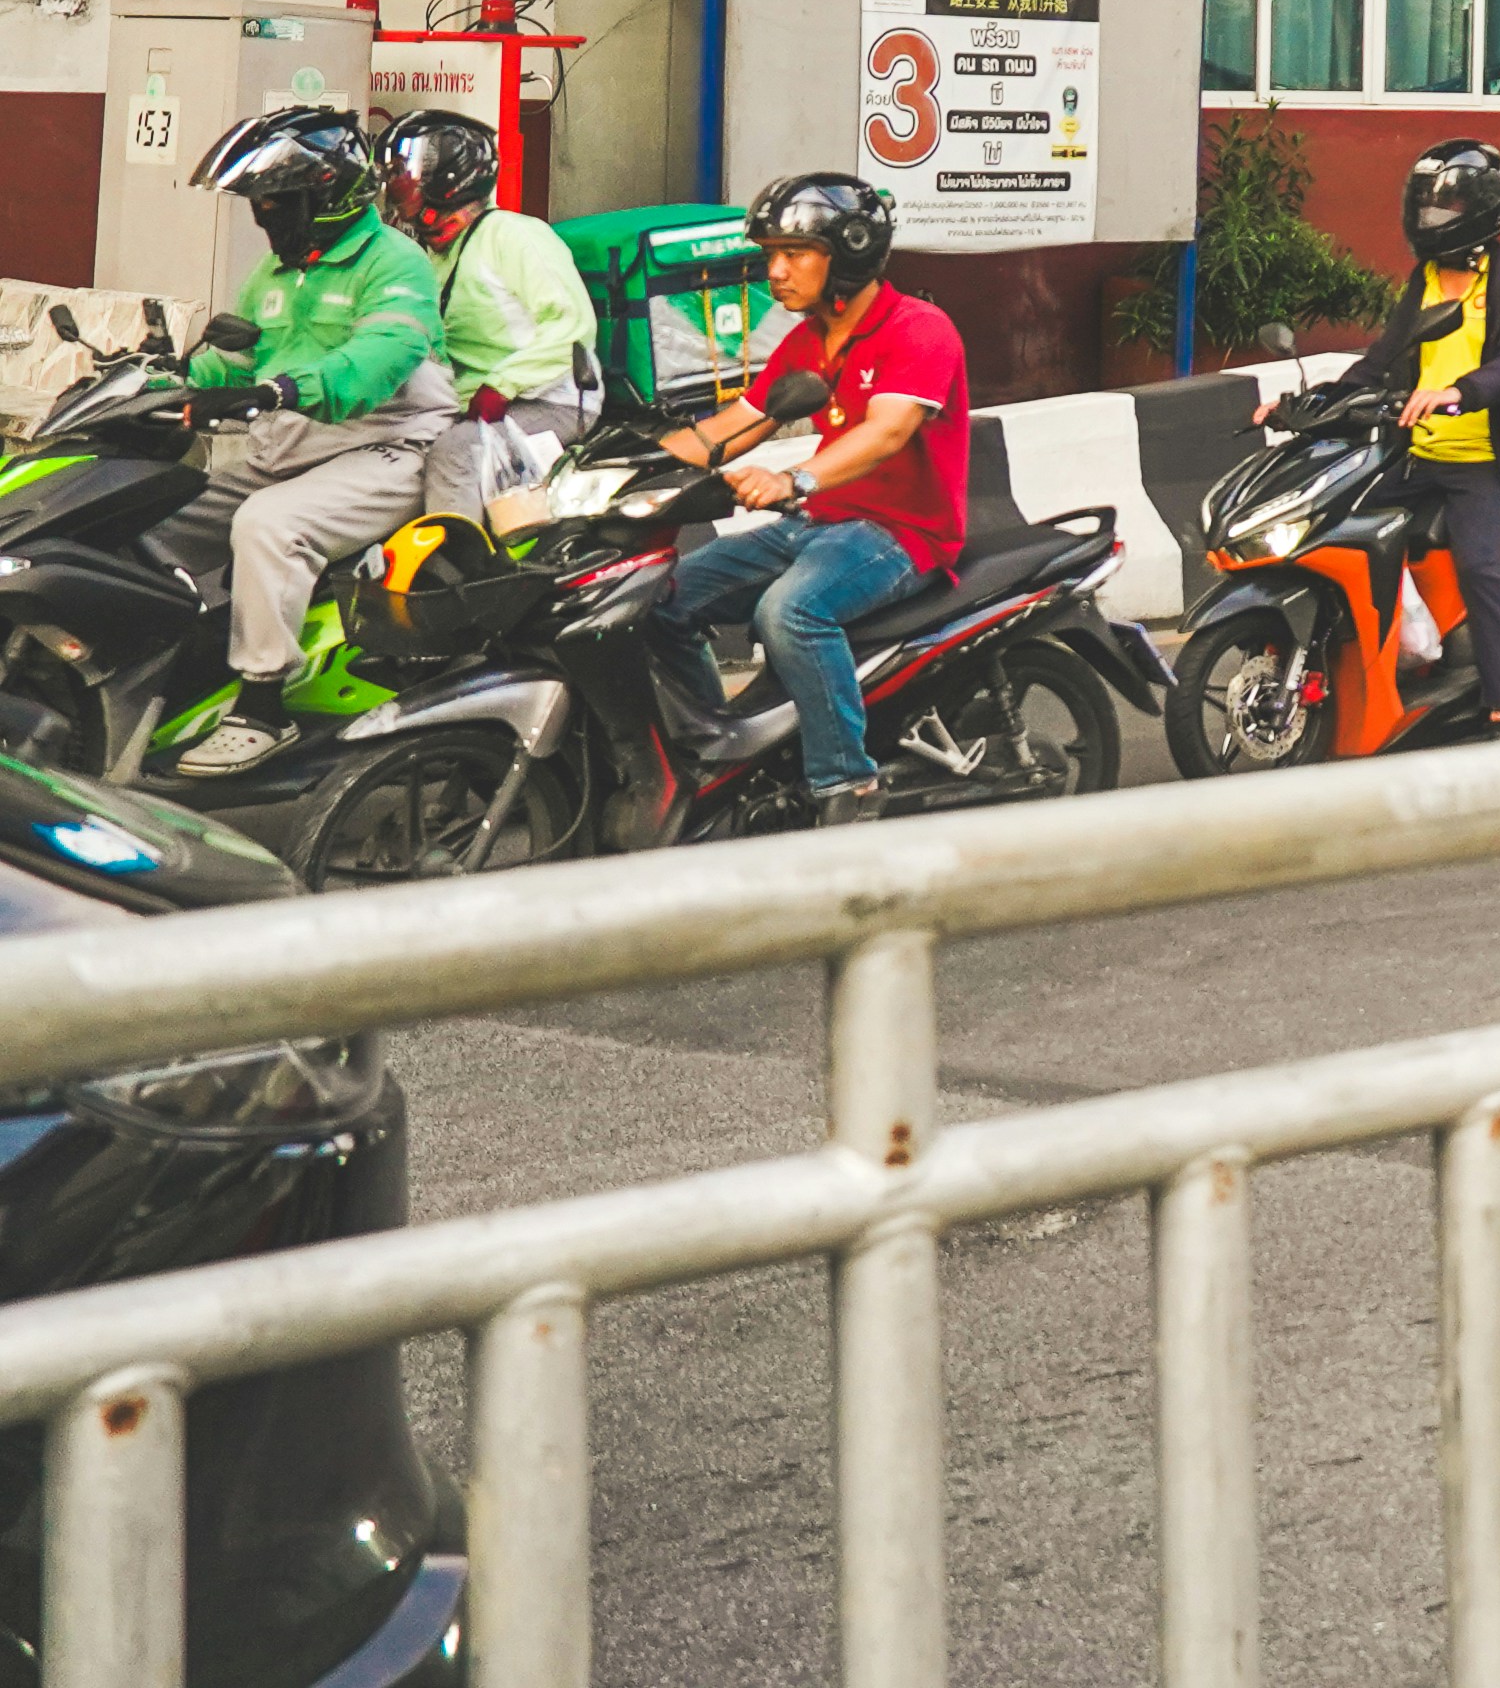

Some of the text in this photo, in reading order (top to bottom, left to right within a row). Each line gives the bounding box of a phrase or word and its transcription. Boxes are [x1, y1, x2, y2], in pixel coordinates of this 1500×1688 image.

[971, 22, 1020, 49] พร้อม
[412, 60, 475, 93] สน.ท่าพระ
[956, 57, 1034, 73] คน รถ ถนน
[864, 27, 941, 169] 3
[866, 90, 892, 106] ด้วย
[991, 82, 1004, 105] มี
[135, 110, 172, 148] 153
[983, 141, 1002, 165] ไม่
